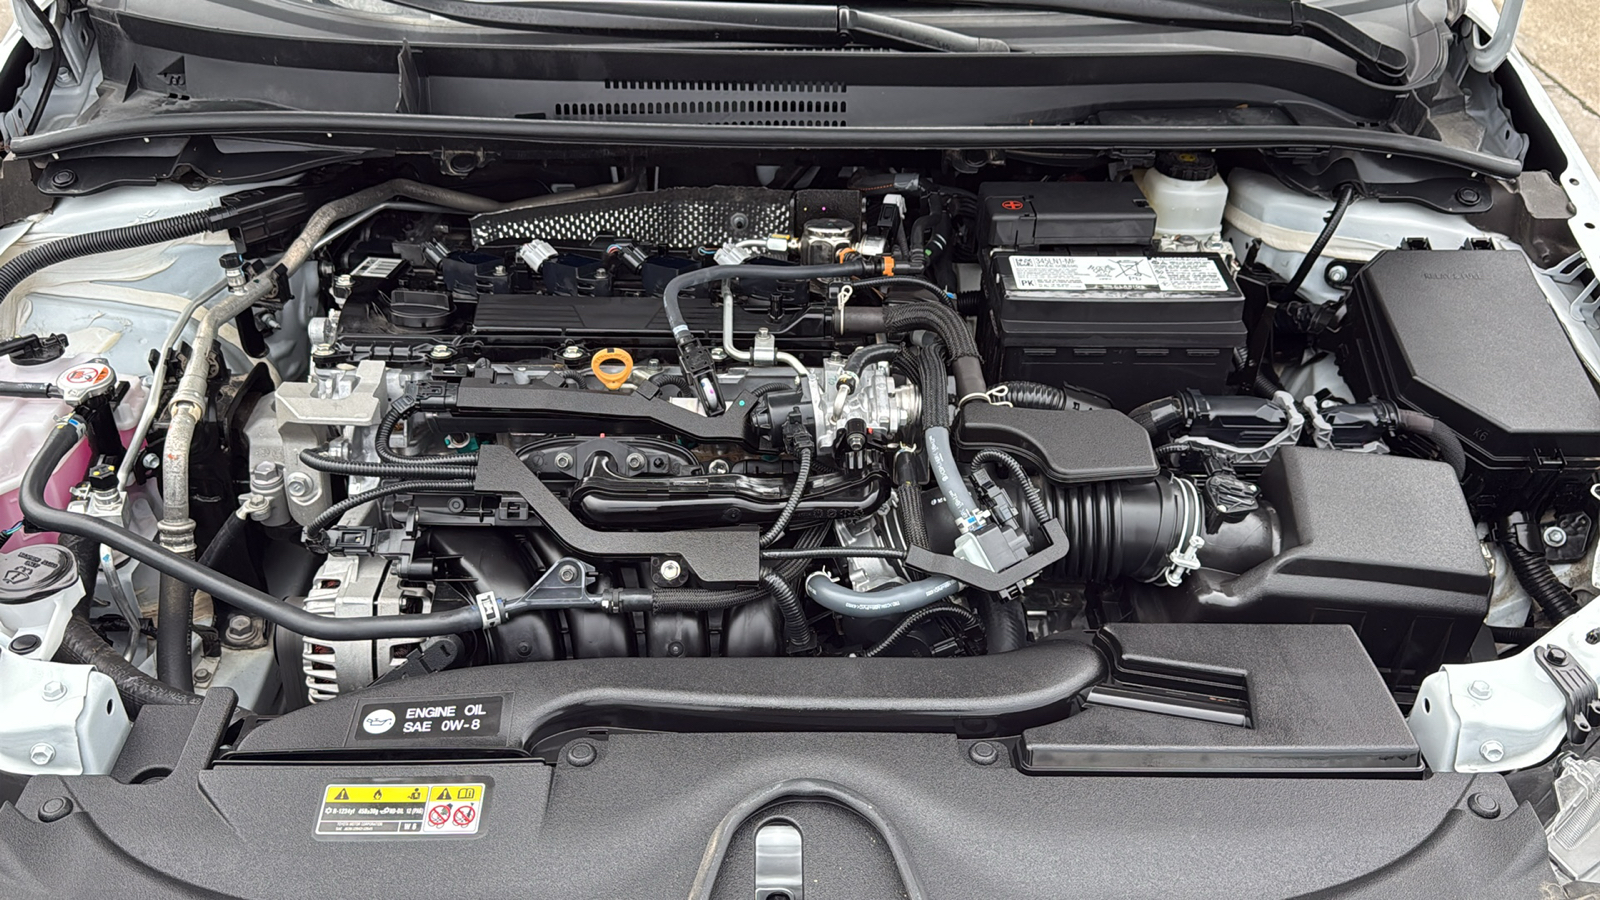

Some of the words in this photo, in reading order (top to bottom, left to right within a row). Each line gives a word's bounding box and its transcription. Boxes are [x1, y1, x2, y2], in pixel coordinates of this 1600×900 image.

[405, 706, 457, 719] ENGINE
[464, 704, 487, 716] OIL
[403, 721, 432, 733] SAE
[441, 719, 481, 731] 0W-8
